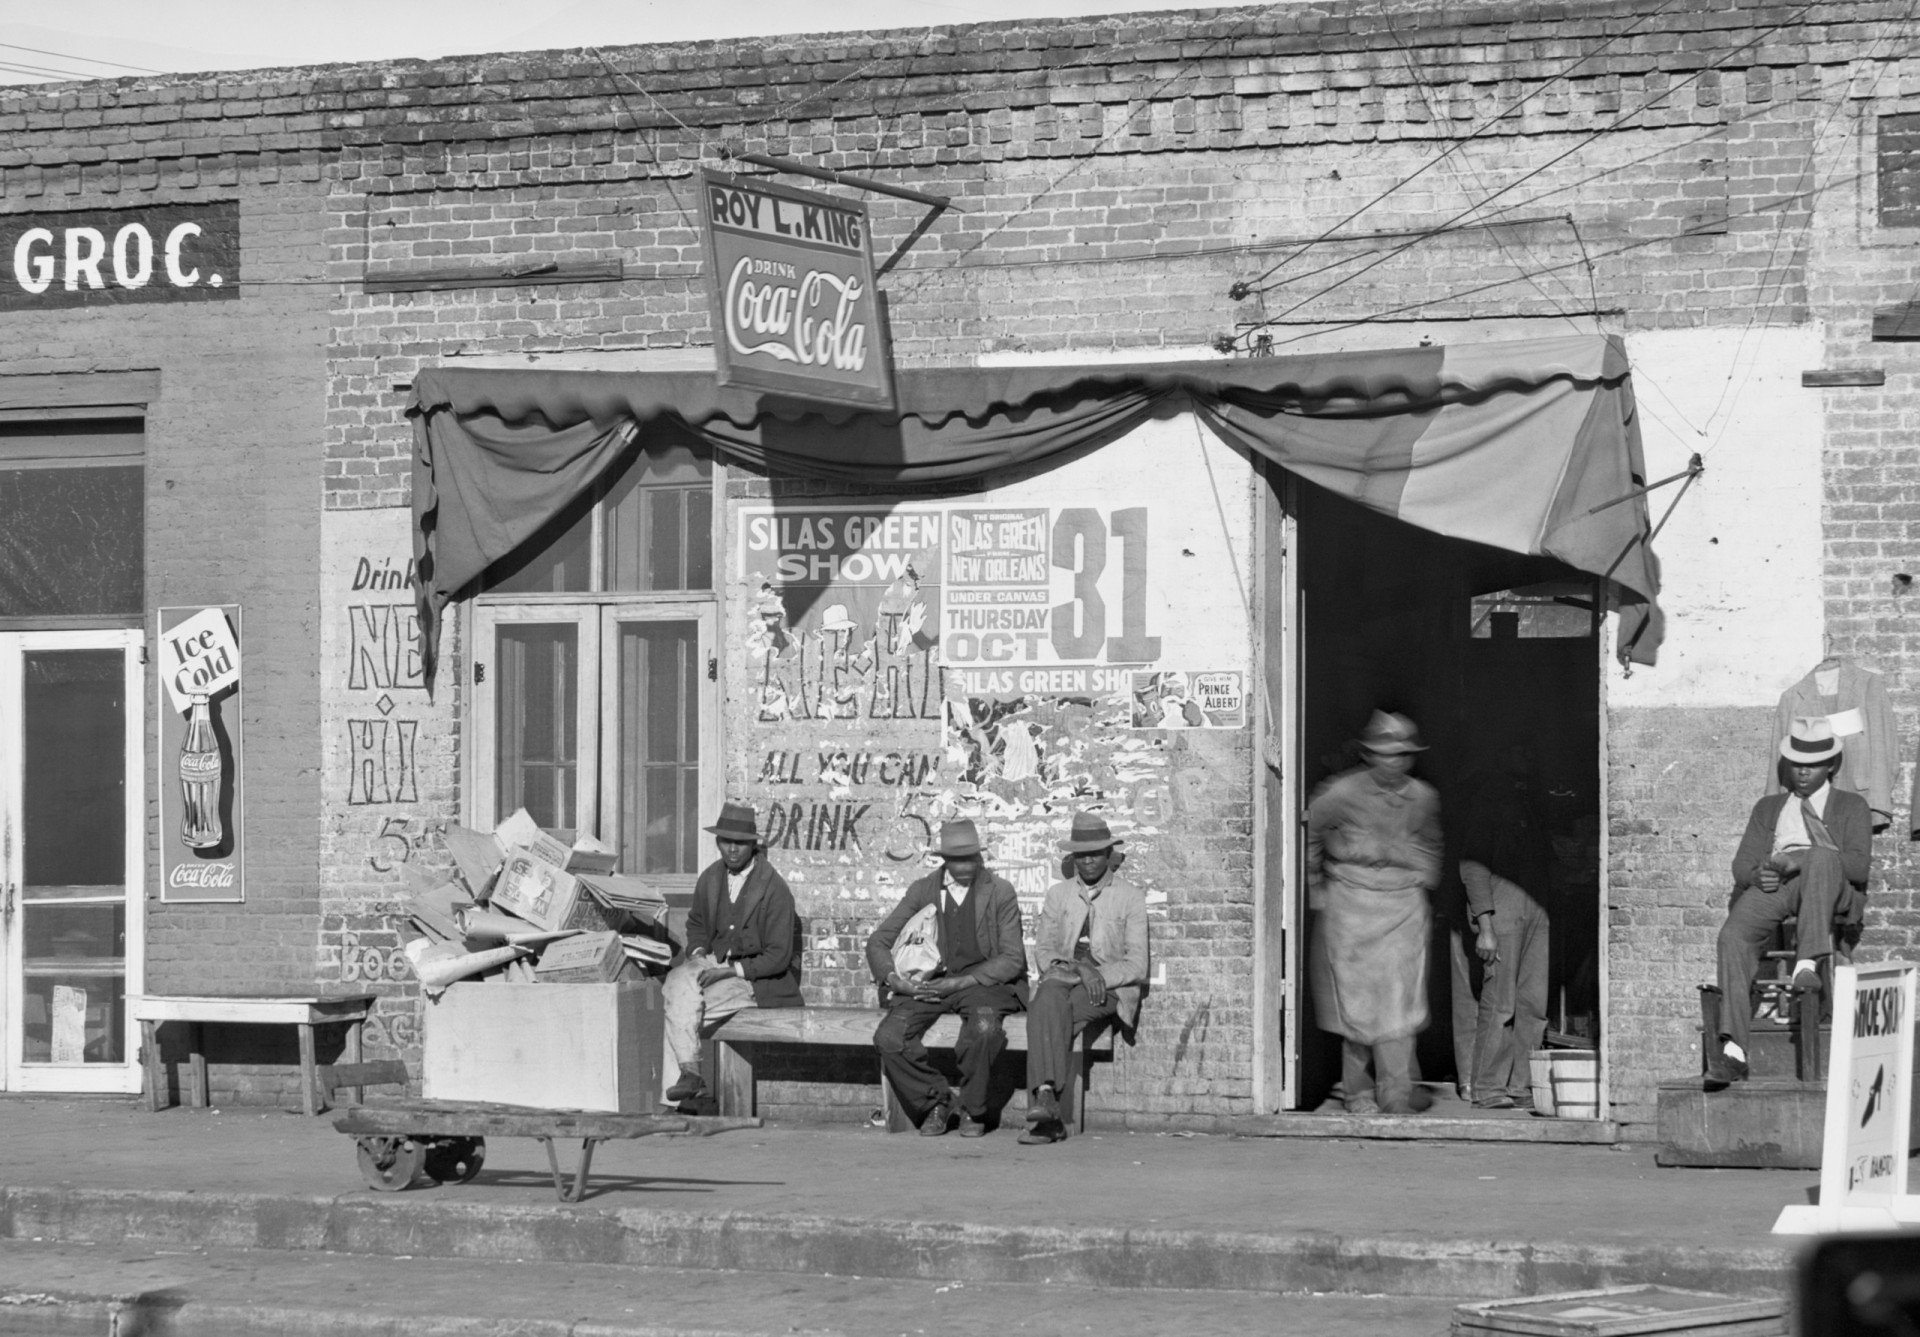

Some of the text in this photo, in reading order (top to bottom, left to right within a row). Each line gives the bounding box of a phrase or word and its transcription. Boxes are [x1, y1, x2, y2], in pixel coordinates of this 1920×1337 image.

[710, 188, 762, 230] ROY
[13, 222, 224, 294] GROC.
[755, 260, 797, 280] DRINK
[749, 515, 940, 551] SILAS GREEN
[951, 513, 1046, 554] SILAS GREEN
[972, 513, 988, 521] THE
[352, 557, 416, 591] Drink
[775, 552, 912, 581] SHOW
[951, 553, 1046, 582] NEW ORLEANS
[946, 507, 1162, 663] OCT 31
[950, 591, 1047, 603] UNDER CANVAS
[947, 609, 1049, 630] THURSDAY
[170, 629, 216, 666] Ice
[175, 646, 234, 695] Cold
[965, 670, 1014, 694] ILAS
[1019, 670, 1087, 693] GREEN
[1091, 669, 1133, 692] SHO
[1198, 684, 1230, 696] PRINCE
[1204, 697, 1239, 709] ALBERT
[348, 719, 418, 806] HI
[757, 750, 804, 785] ALL
[879, 752, 940, 787] CAN
[766, 801, 872, 851] DRINK
